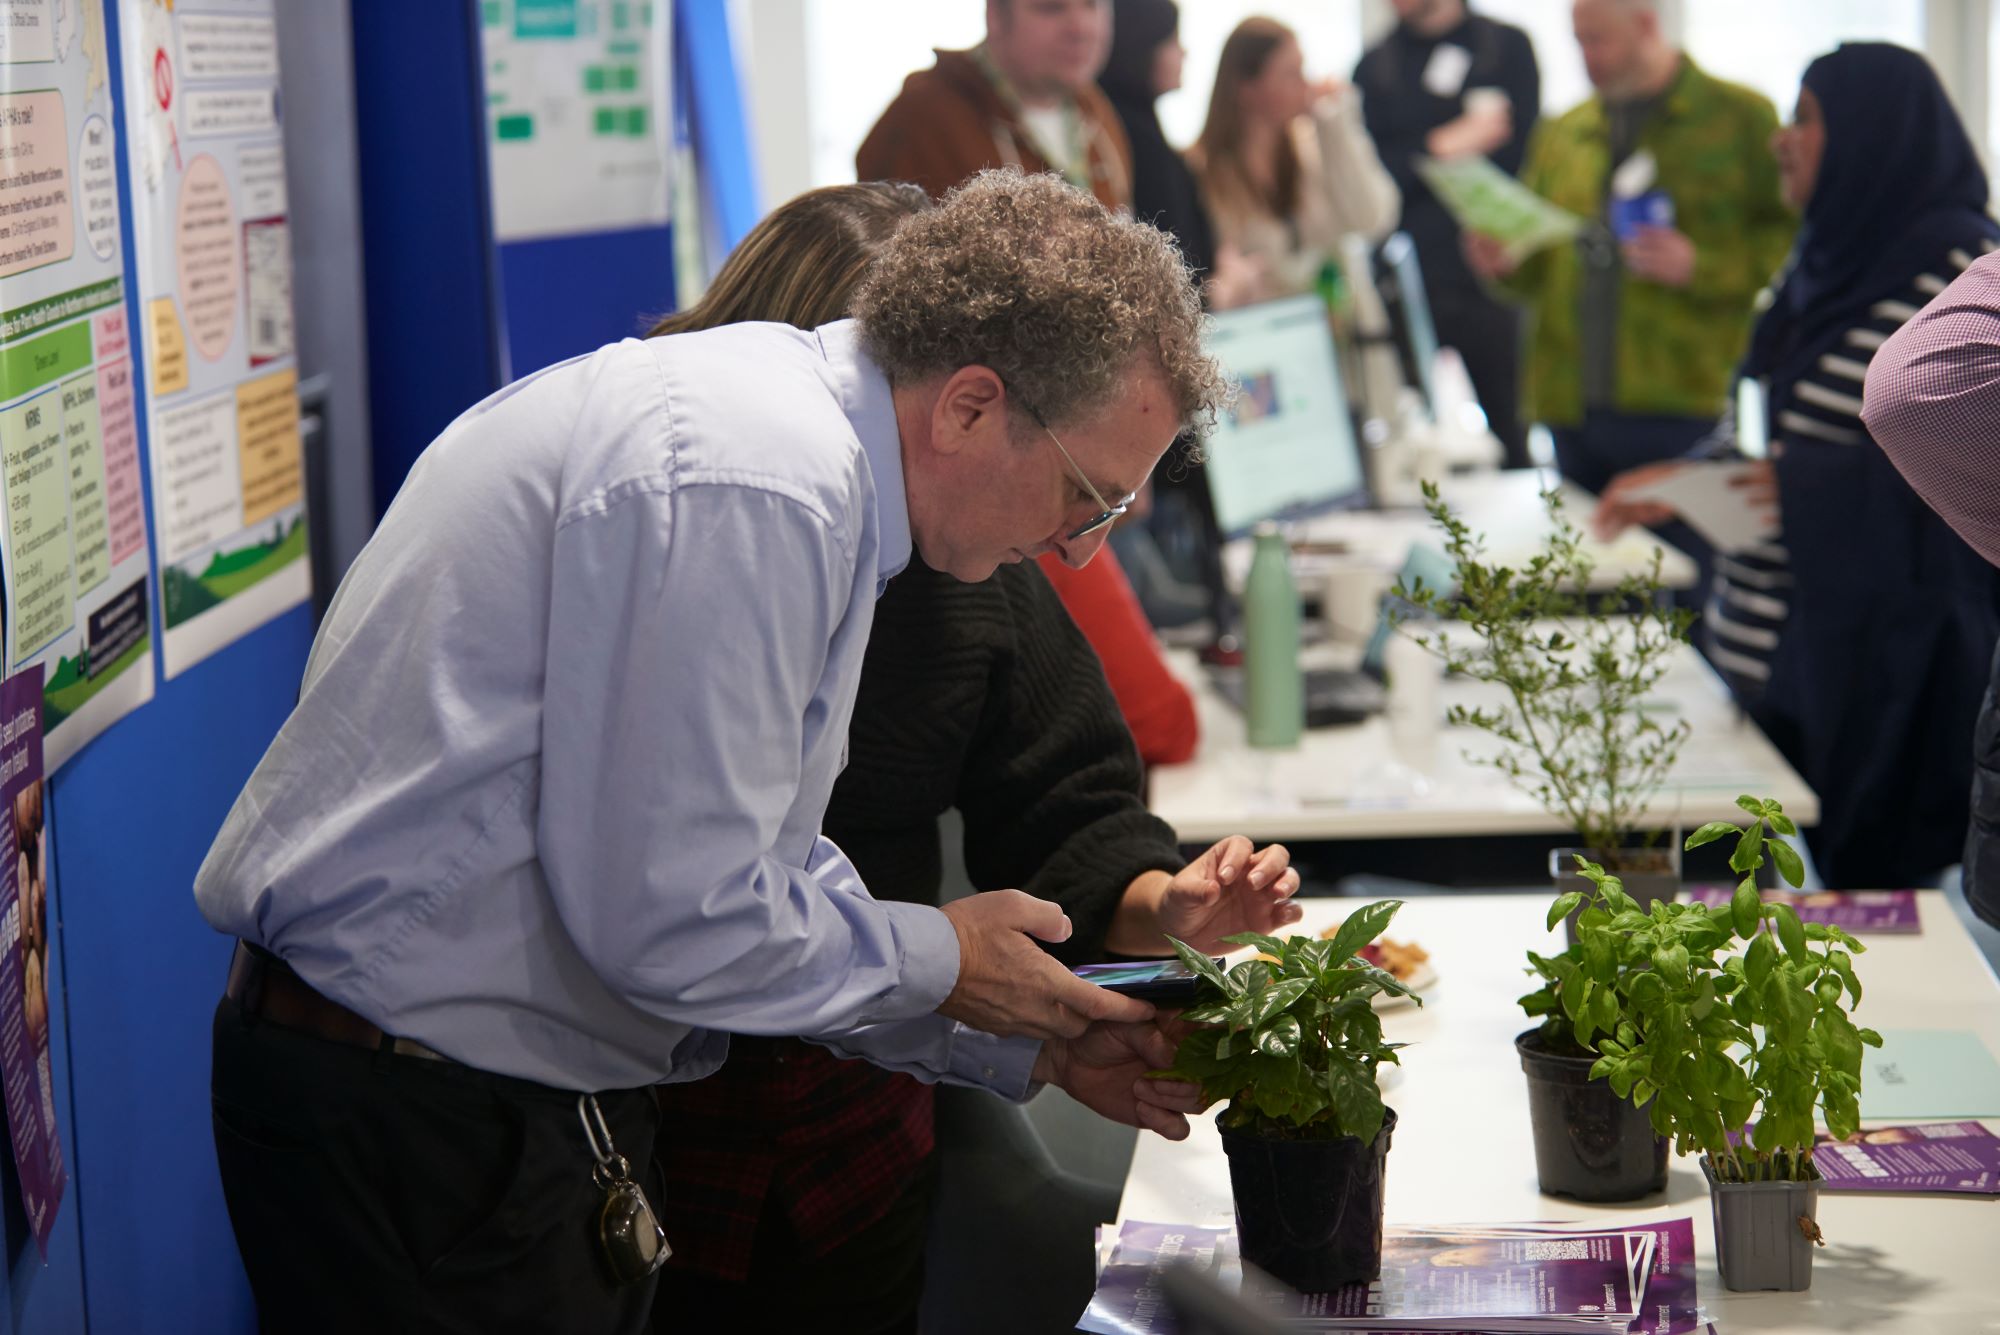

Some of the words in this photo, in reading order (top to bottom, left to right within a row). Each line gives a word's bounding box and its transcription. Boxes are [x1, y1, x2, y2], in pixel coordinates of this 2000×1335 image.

[3, 714, 14, 747] seed
[15, 706, 37, 744] potatoes
[13, 740, 29, 777] Ireland
[1602, 1284, 1616, 1306] Government
[1655, 1305, 1670, 1329] Government
